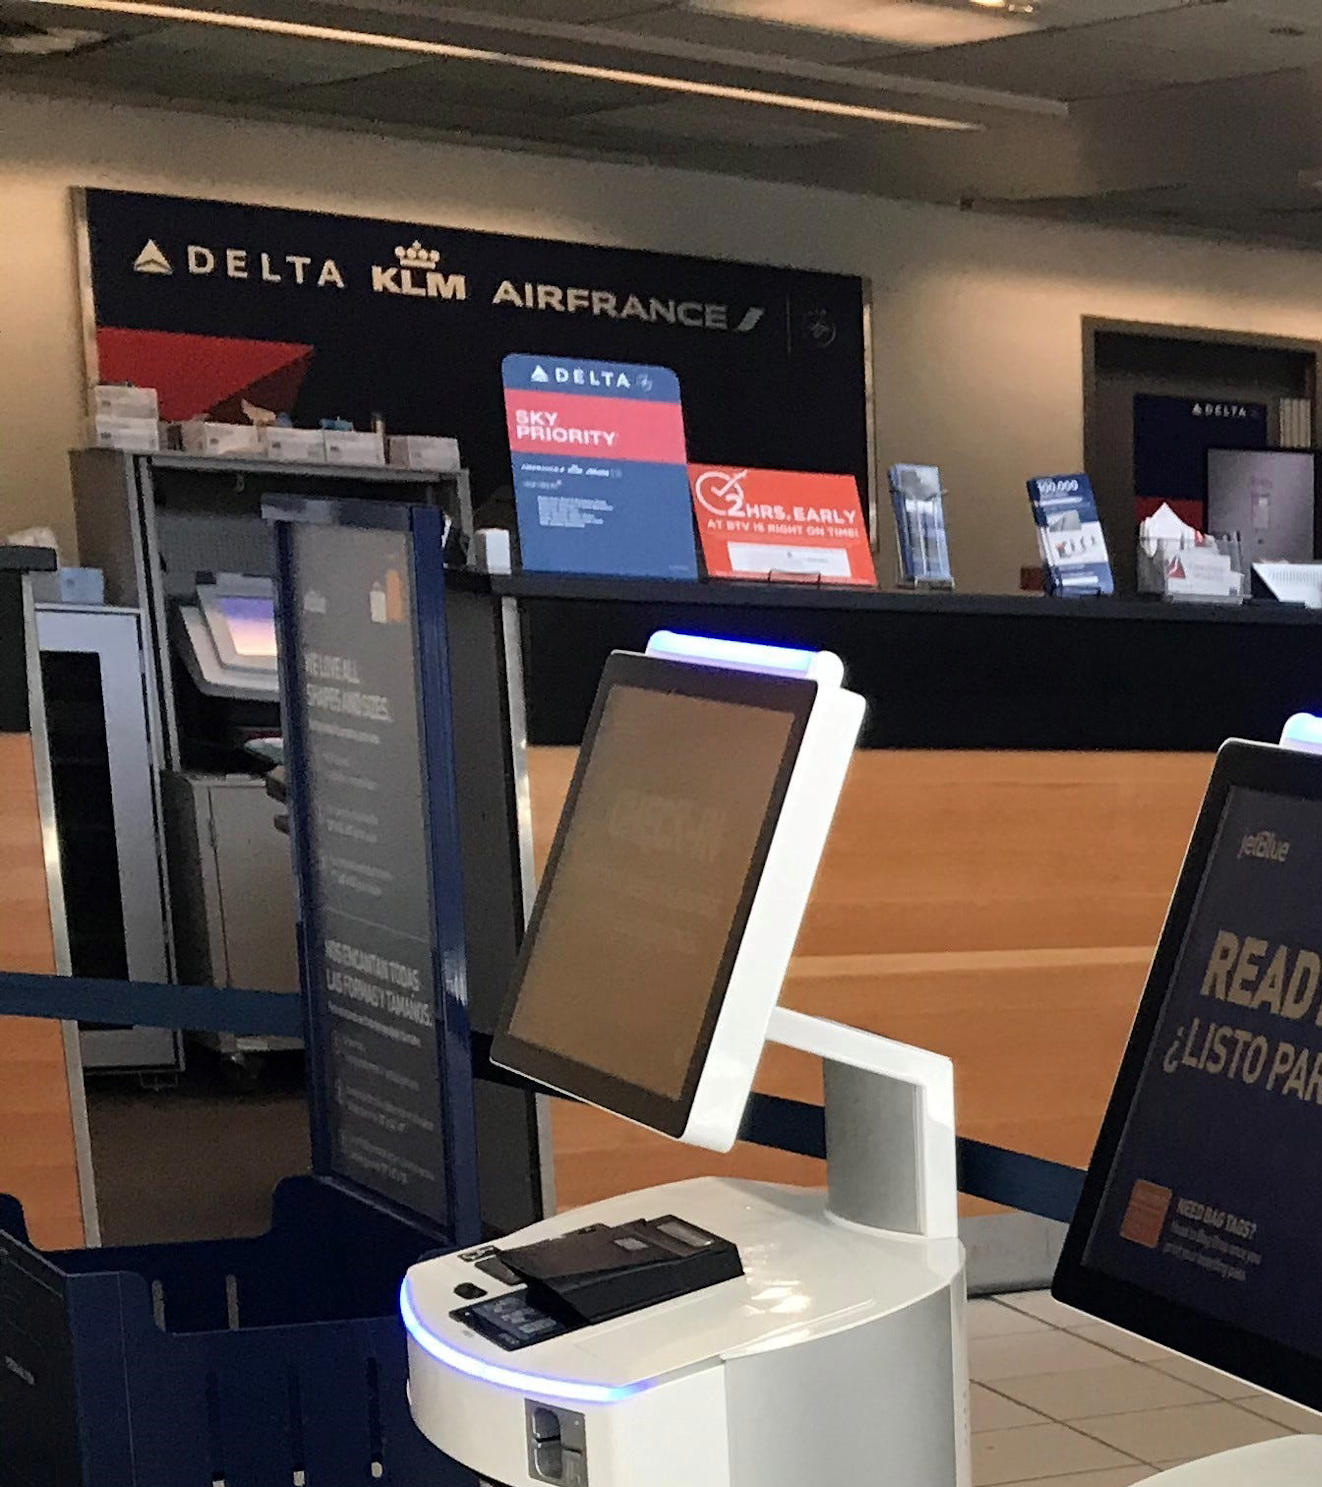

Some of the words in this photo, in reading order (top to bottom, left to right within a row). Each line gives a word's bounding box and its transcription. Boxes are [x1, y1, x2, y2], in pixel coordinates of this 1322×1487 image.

[187, 245, 344, 288] DELTA
[371, 265, 467, 300] KLM
[493, 280, 729, 329] AIRFRANCE
[555, 367, 631, 389] DELTA
[515, 409, 558, 426] SKY
[1204, 403, 1246, 417] DELTA
[516, 425, 616, 446] PRIORITY
[707, 519, 723, 529] AT
[793, 506, 856, 524] EARLY
[1163, 1017, 1269, 1084] ¿LISTO
